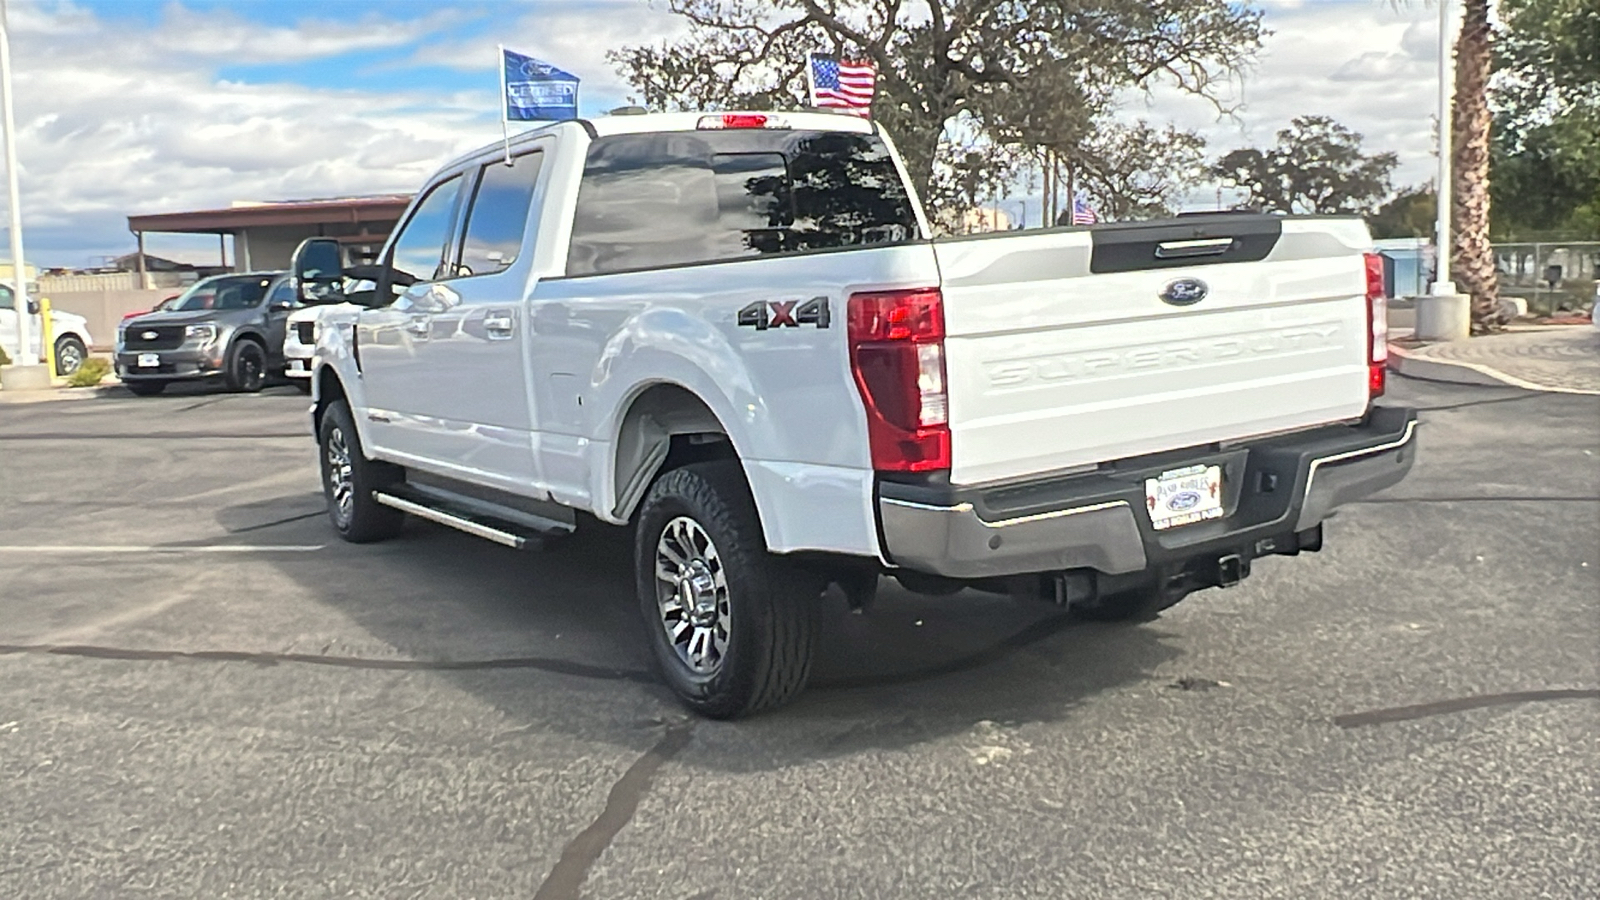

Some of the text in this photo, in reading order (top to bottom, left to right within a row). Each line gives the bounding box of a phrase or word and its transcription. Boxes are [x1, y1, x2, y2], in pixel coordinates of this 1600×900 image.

[989, 325, 1340, 387] SUPER DUTY
[1180, 476, 1210, 491] ROBLES
